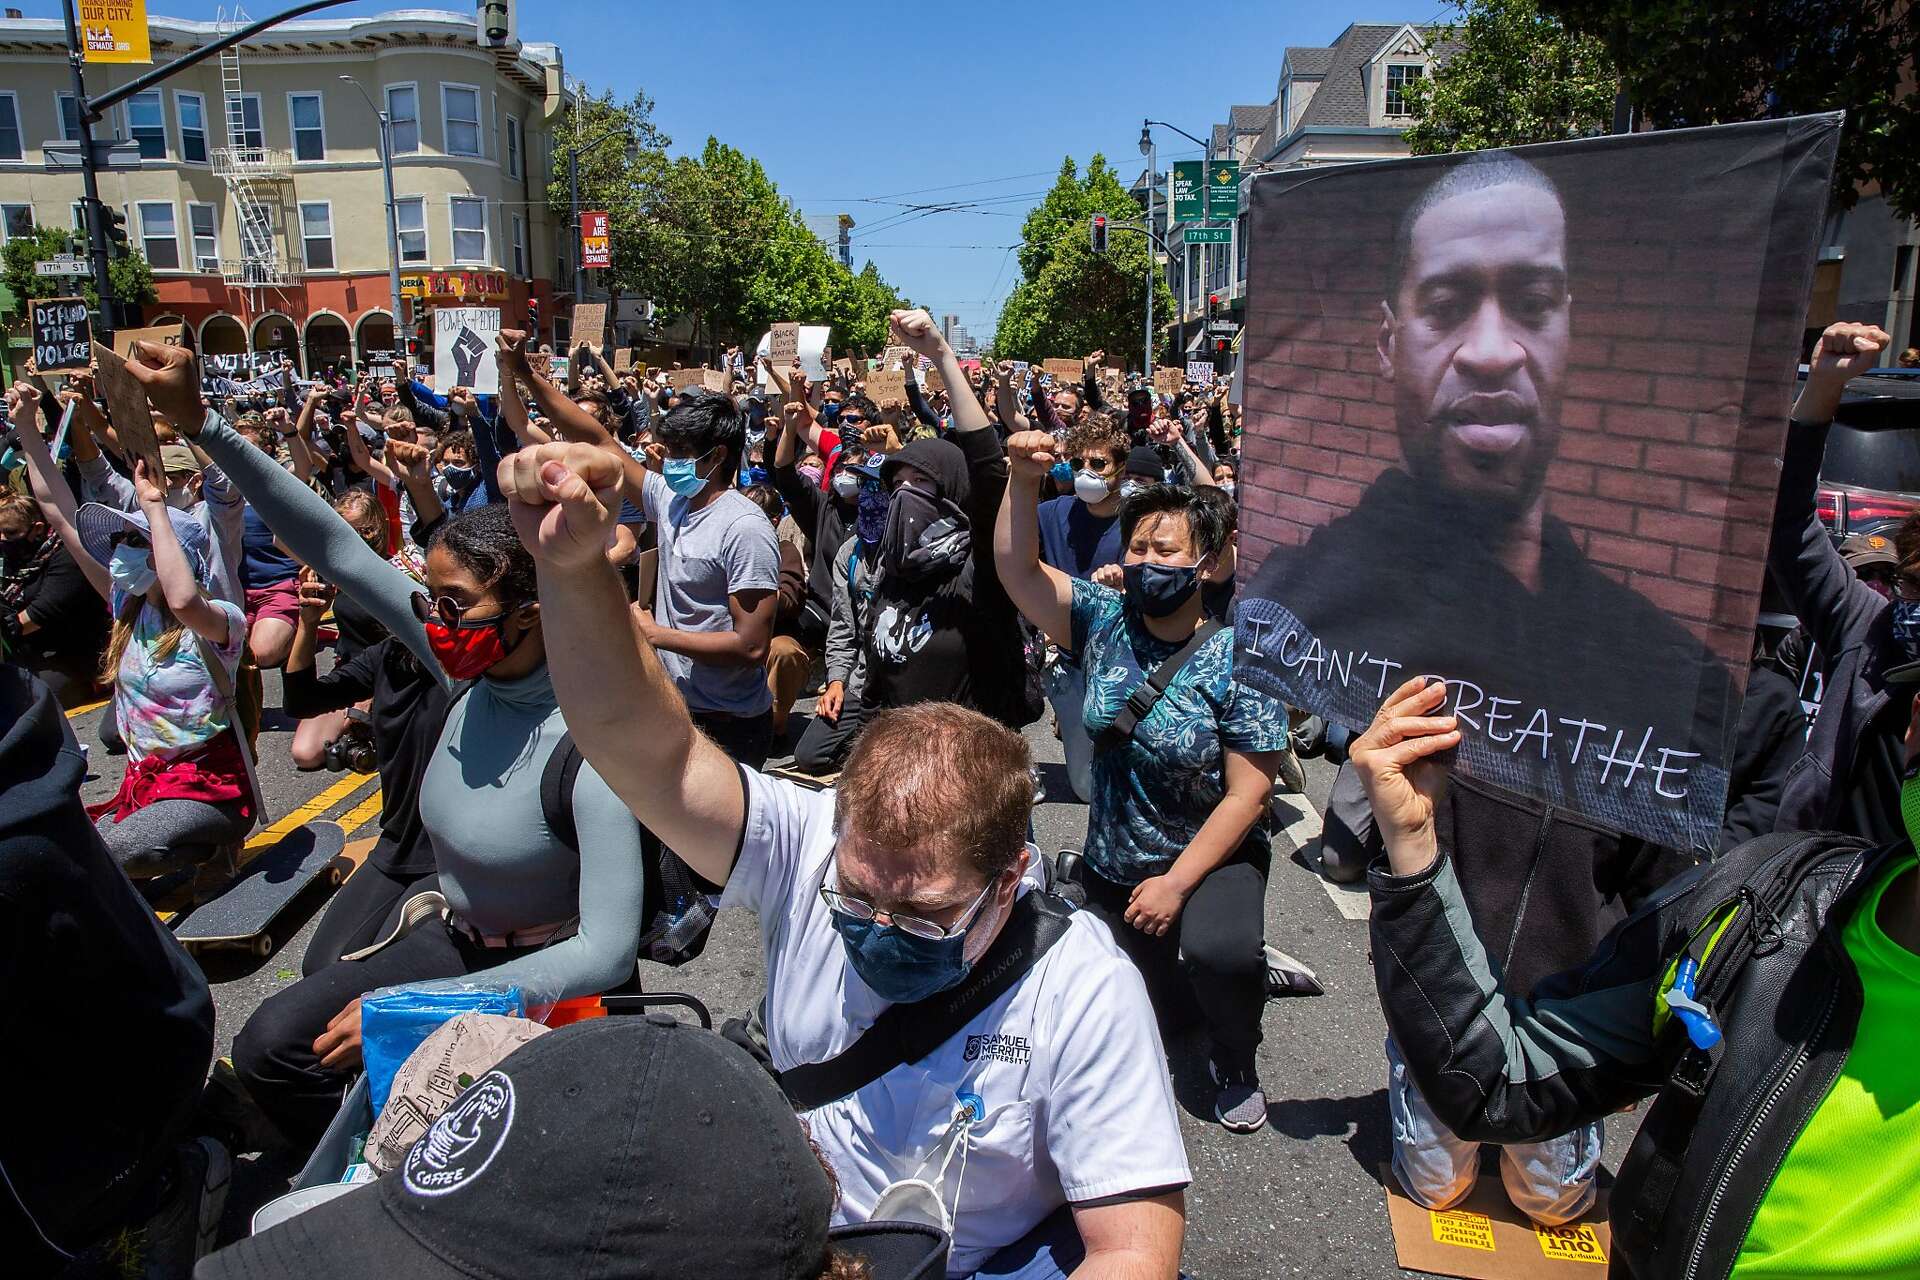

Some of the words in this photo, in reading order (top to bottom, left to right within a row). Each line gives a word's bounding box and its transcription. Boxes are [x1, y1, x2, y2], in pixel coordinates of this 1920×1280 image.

[82, 7, 104, 20] OUR
[107, 8, 133, 21] CITY.
[1175, 194, 1183, 202] TO
[594, 216, 607, 227] WE
[592, 227, 607, 237] ARE
[1188, 232, 1208, 240] 17th
[1214, 232, 1224, 240] St
[586, 255, 608, 264] SFMADE
[43, 264, 60, 272] 17TH
[72, 263, 85, 271] ST
[400, 279, 426, 288] UERIA
[428, 272, 456, 294] EL
[461, 272, 504, 294] TORO
[36, 304, 87, 325] DEFUND
[436, 310, 468, 333] POWER
[42, 324, 75, 342] THE
[36, 341, 89, 366] POLICE
[1245, 616, 1271, 658] I
[1280, 630, 1402, 699] CAN'T
[982, 1033, 1031, 1049] SAMUEL
[981, 1045, 1030, 1059] MERRITT
[980, 1054, 1029, 1065] UNIVERSITY
[416, 1168, 465, 1186] COFFEE
[1441, 1226, 1487, 1240] Pence
[1537, 1225, 1594, 1242] NOW
[1440, 1233, 1493, 1249] Trump/
[1549, 1239, 1594, 1253] OUT
